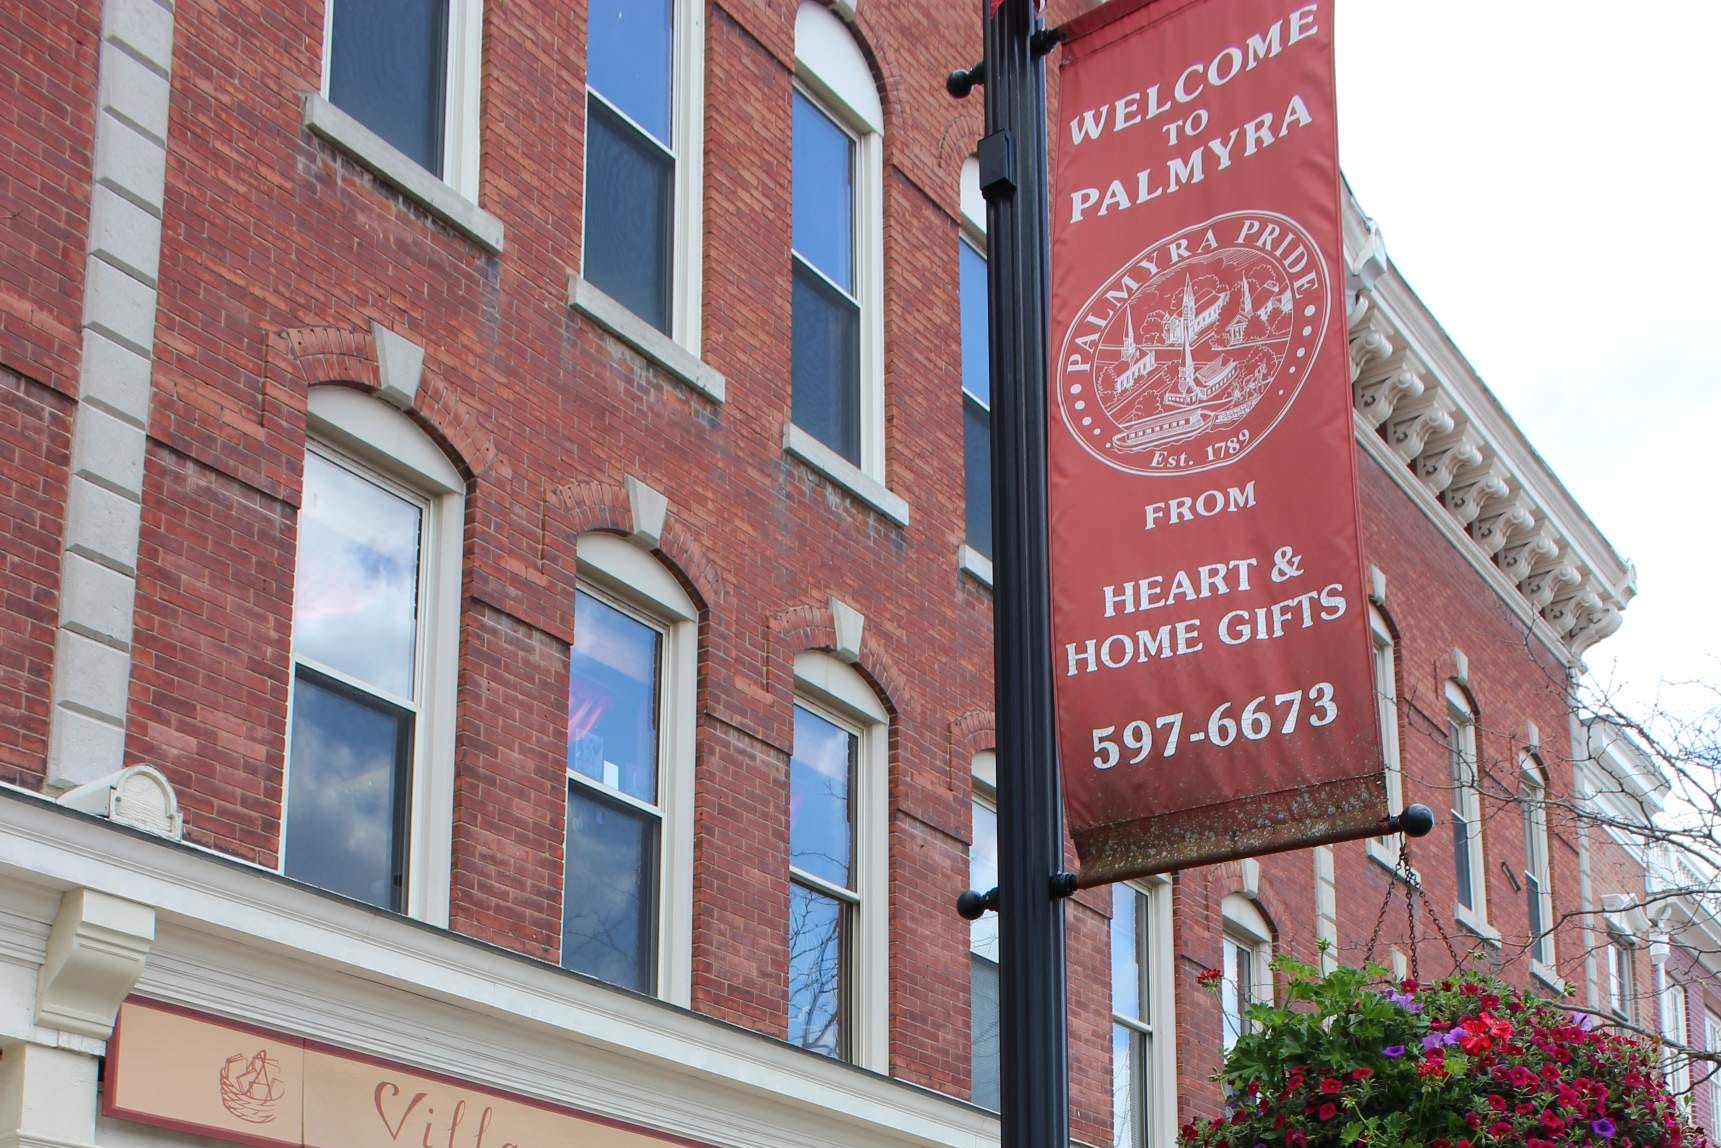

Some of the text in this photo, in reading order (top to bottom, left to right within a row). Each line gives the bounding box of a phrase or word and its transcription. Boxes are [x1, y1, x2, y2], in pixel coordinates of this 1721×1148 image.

[1069, 3, 1319, 146] WELCOME
[1070, 94, 1313, 224] PALMYRA
[1162, 108, 1209, 146] TO
[1066, 219, 1320, 375] PALMYRA PRIDE
[1150, 429, 1251, 468] Est. 1789
[1144, 481, 1256, 530] FROM
[1103, 546, 1304, 618] HEART &
[1065, 584, 1347, 676] HOME GIFTS
[1092, 682, 1339, 770] 597-6673
